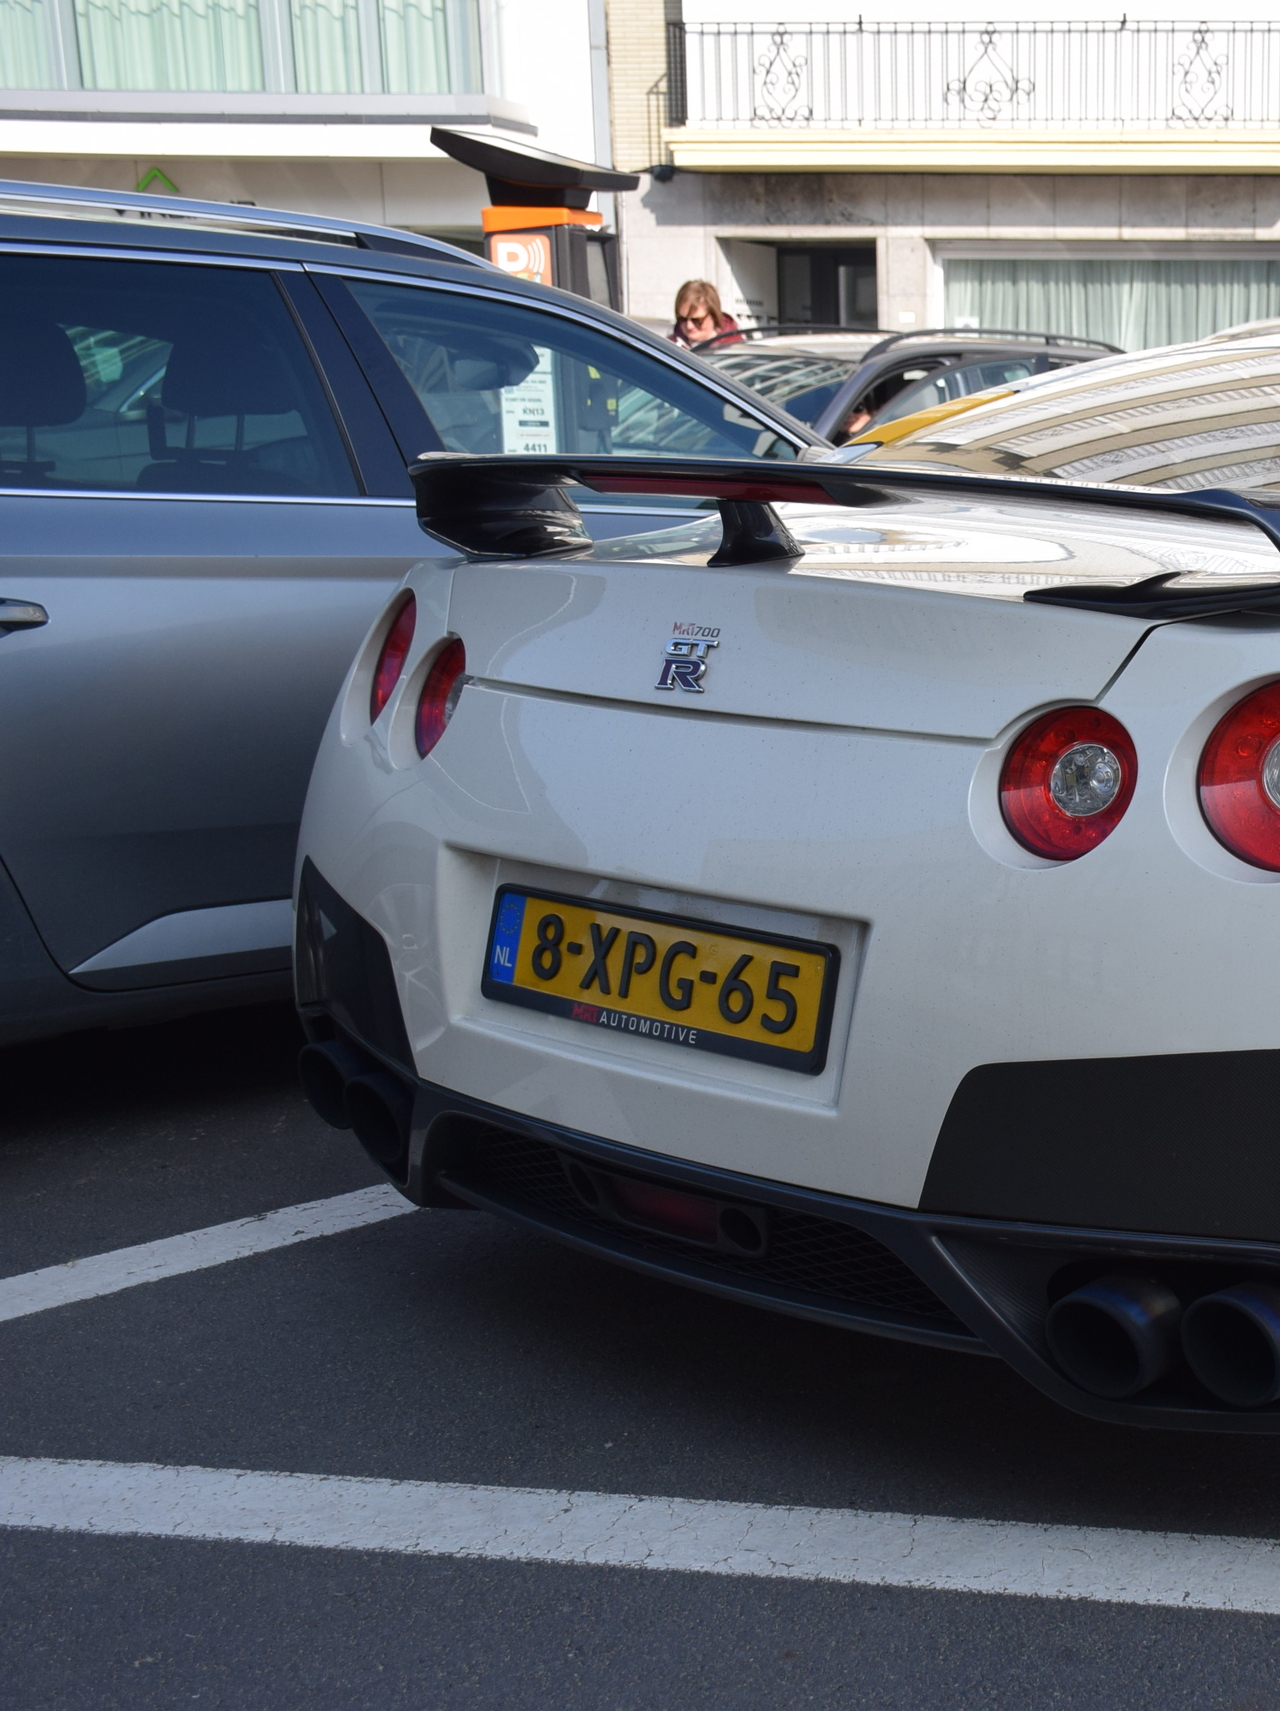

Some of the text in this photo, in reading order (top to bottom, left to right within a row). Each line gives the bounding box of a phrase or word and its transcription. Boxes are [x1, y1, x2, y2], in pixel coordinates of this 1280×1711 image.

[523, 443, 548, 453] 4411
[665, 638, 720, 659] GT
[654, 656, 705, 693] R
[494, 944, 513, 968] NL
[531, 912, 802, 1035] 8-XPG-65
[598, 1010, 698, 1045] AUTOMOTIVE
